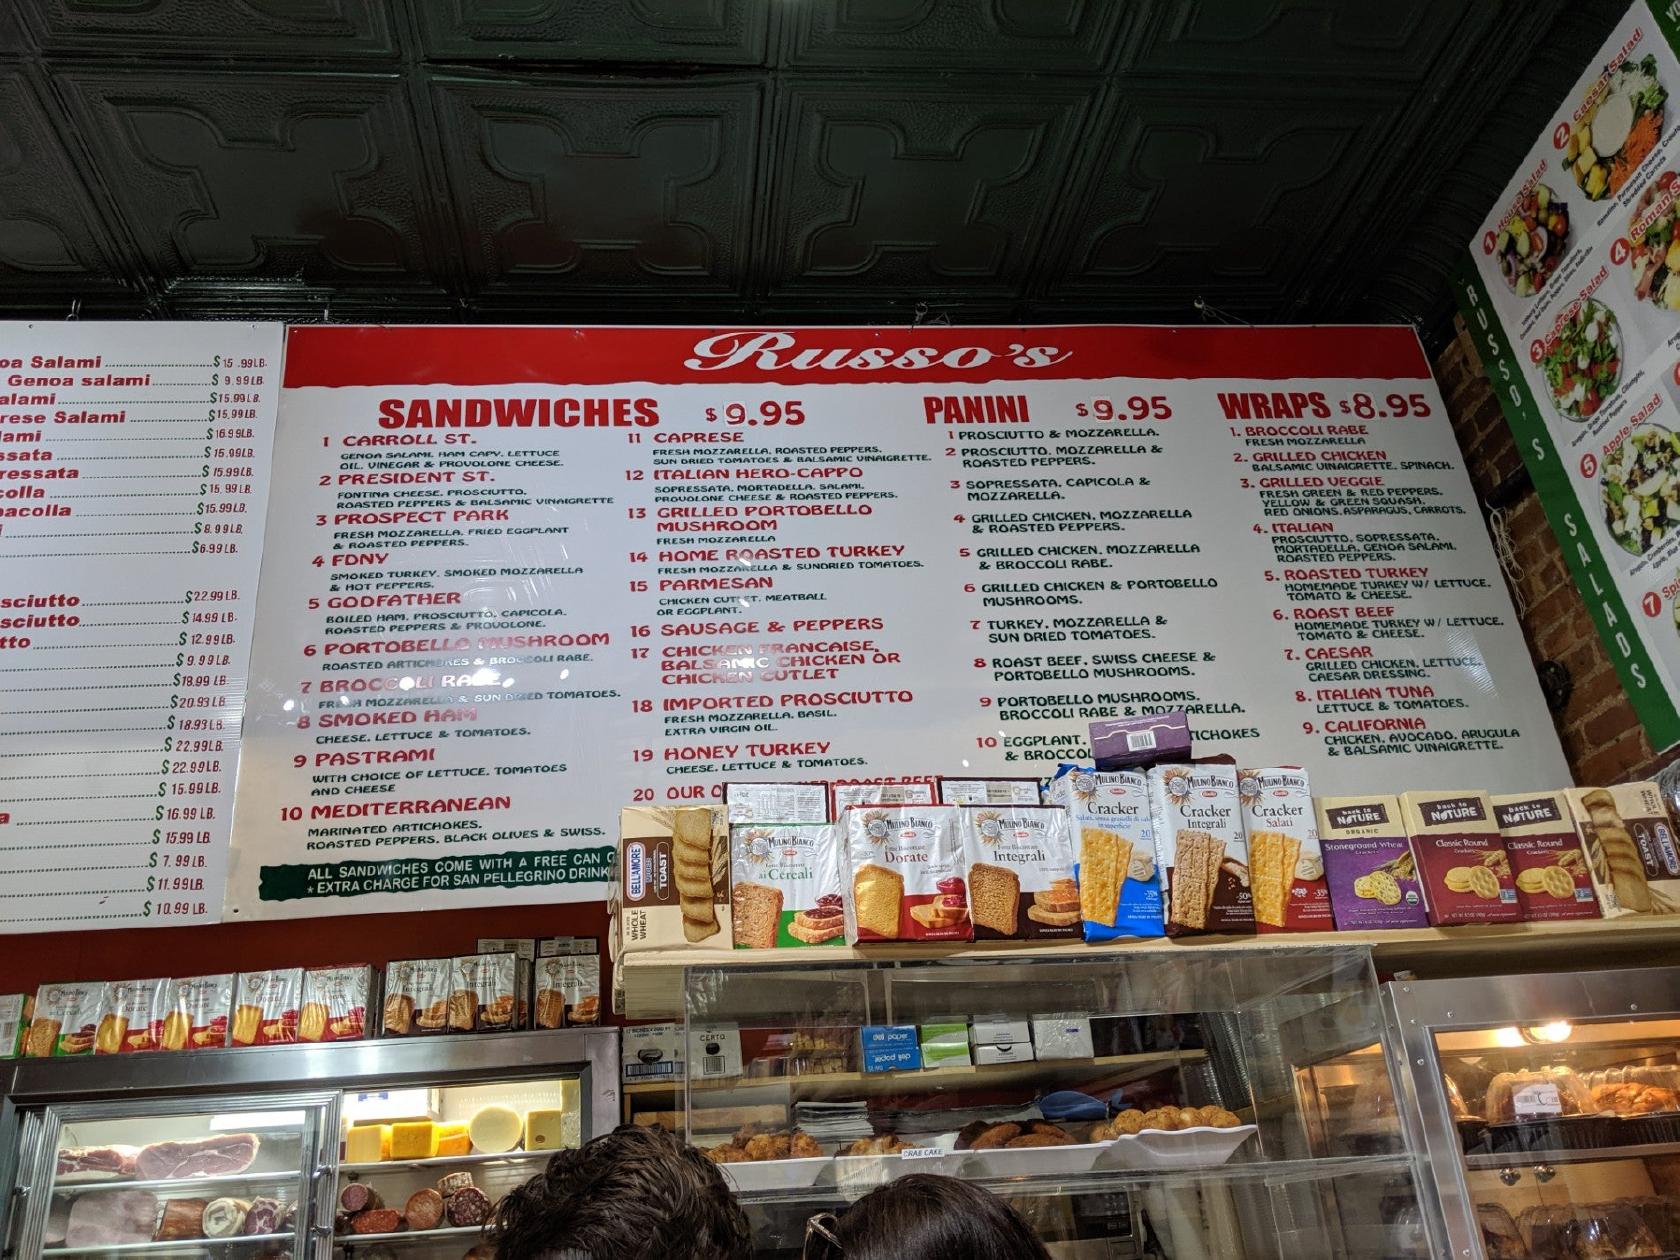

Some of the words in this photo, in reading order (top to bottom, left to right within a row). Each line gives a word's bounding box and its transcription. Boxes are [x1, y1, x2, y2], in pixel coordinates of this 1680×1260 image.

[1608, 27, 1643, 75] Salad
[1630, 196, 1671, 241] Roman
[1579, 266, 1610, 303] Salad
[684, 331, 1072, 370] Russo's
[31, 356, 101, 368] Salami
[8, 375, 73, 386] Genoa
[82, 374, 150, 386] salami
[924, 395, 1030, 424] PANINI
[1217, 392, 1331, 419] WRAPS
[54, 411, 125, 423] Salami
[378, 398, 659, 429] SANDWICHES
[1245, 426, 1324, 436] BROCCOLI
[1327, 425, 1369, 435] RABE
[1603, 424, 1632, 455] Apple
[1630, 393, 1662, 428] Salad
[343, 434, 437, 447] CARROLL
[444, 433, 476, 444] ST.
[654, 432, 744, 443] CAPRESE
[959, 430, 1044, 440] PROSCIUTTO
[1049, 430, 1061, 438] &
[963, 458, 1027, 468] ROASTED
[1031, 456, 1096, 466] PEPPERS.
[1321, 451, 1387, 461] CHICKEN
[338, 472, 455, 485] PRESIDENT
[462, 471, 495, 482] ST.
[654, 469, 729, 480] ITALIAN
[736, 467, 863, 478] HERO-CAPPO
[1330, 476, 1384, 487] VEGGIE
[536, 497, 613, 505] VINAIGRETTE
[334, 511, 446, 525] PROSPECT
[453, 509, 509, 522] PARK
[657, 507, 738, 518] GRILLED
[745, 504, 872, 516] PORTOBELLO
[657, 520, 777, 532] MUSHROOM
[1272, 523, 1333, 533] ITALIAN
[698, 535, 776, 543] MOZZARELLA
[332, 553, 389, 566] FDNY
[659, 550, 719, 562] HOME
[827, 545, 904, 557] TURKEY
[996, 560, 1067, 570] BROCCOLI
[1071, 559, 1112, 568] RABE.
[1284, 568, 1362, 580] ROASTED
[1365, 567, 1428, 578] TURKEY
[660, 577, 773, 591] PARMESAN
[1044, 581, 1104, 592] CHICKEN
[1127, 578, 1218, 589] PORTOBELLO
[327, 592, 461, 608] GODFATHER
[983, 595, 1082, 607] MUSHROOMS.
[1293, 607, 1349, 619] ROAST
[1355, 606, 1394, 618] BEEF
[661, 622, 759, 636] SAUSAGE
[767, 621, 785, 632] &
[793, 618, 883, 631] PEPPERS
[1023, 631, 1066, 642] DRIED
[1071, 629, 1155, 640] TOMATOES.
[324, 639, 448, 656] PORTOBELLO
[1305, 646, 1373, 660] CAESAR
[872, 653, 901, 664] OR
[992, 657, 1042, 668] ROAST
[1092, 654, 1138, 665] SWISS
[1142, 652, 1197, 663] CHEESE
[1317, 687, 1382, 701] ITALIAN
[1385, 685, 1434, 698] TUNA
[663, 695, 773, 711] IMPORTED
[781, 690, 913, 707] PROSCIUTTO
[1393, 698, 1469, 710] TOMATOES.
[318, 711, 417, 728] SMOKED
[424, 709, 476, 722] HAM
[1325, 717, 1426, 733] CALIFORNIA
[665, 727, 706, 736] EXTRA
[709, 725, 750, 734] VIRGIN
[315, 748, 435, 767] PASTRAMI
[664, 745, 738, 760] HONEY
[745, 742, 830, 757] TURKEY
[312, 775, 347, 783] WITH
[351, 772, 400, 782] CHOICE
[405, 771, 423, 779] OF
[1095, 774, 1119, 788] MULINO
[1118, 774, 1142, 787] BIANCO
[311, 787, 340, 796] AND
[344, 784, 395, 794] CHEESE
[667, 785, 705, 799] OUR
[281, 807, 302, 821] 10
[311, 796, 510, 820] MEDITERRANEAN
[1087, 801, 1139, 816] Cracker
[1180, 805, 1232, 819] Cracker
[1252, 804, 1303, 818] Cracker
[1187, 818, 1227, 832] Integrali
[1265, 818, 1294, 828] Salati
[308, 825, 387, 837] MARINATED
[444, 833, 487, 843] BLACK
[492, 830, 539, 840] OLIVES
[560, 827, 605, 837] SWISS.
[1324, 841, 1378, 850] Stoneground
[1435, 839, 1463, 848] Classic
[1464, 838, 1489, 847] Round
[1507, 841, 1536, 850] Classic
[1533, 838, 1564, 848] Round
[884, 851, 929, 864] Dorate
[993, 849, 1046, 865] Integrali
[1637, 833, 1654, 869] TOAST
[307, 867, 333, 881] ALL
[338, 862, 429, 878] SANDWICHES
[434, 860, 473, 873] COME
[479, 857, 513, 871] WITH
[518, 856, 528, 868] A
[533, 854, 568, 867] FREE
[573, 852, 601, 865] CAN
[659, 852, 668, 890] TOAST
[316, 880, 361, 894] EXTRA
[362, 876, 419, 892] CHARGE
[422, 875, 450, 888] FOR
[453, 874, 481, 886] SAN
[483, 868, 566, 885] PELLEGRINO
[767, 867, 813, 881] Cereali
[630, 909, 639, 941] WHOLE
[639, 910, 647, 941] WHEAT
[887, 1033, 908, 1042] paper
[924, 1148, 943, 1156] CAKE
